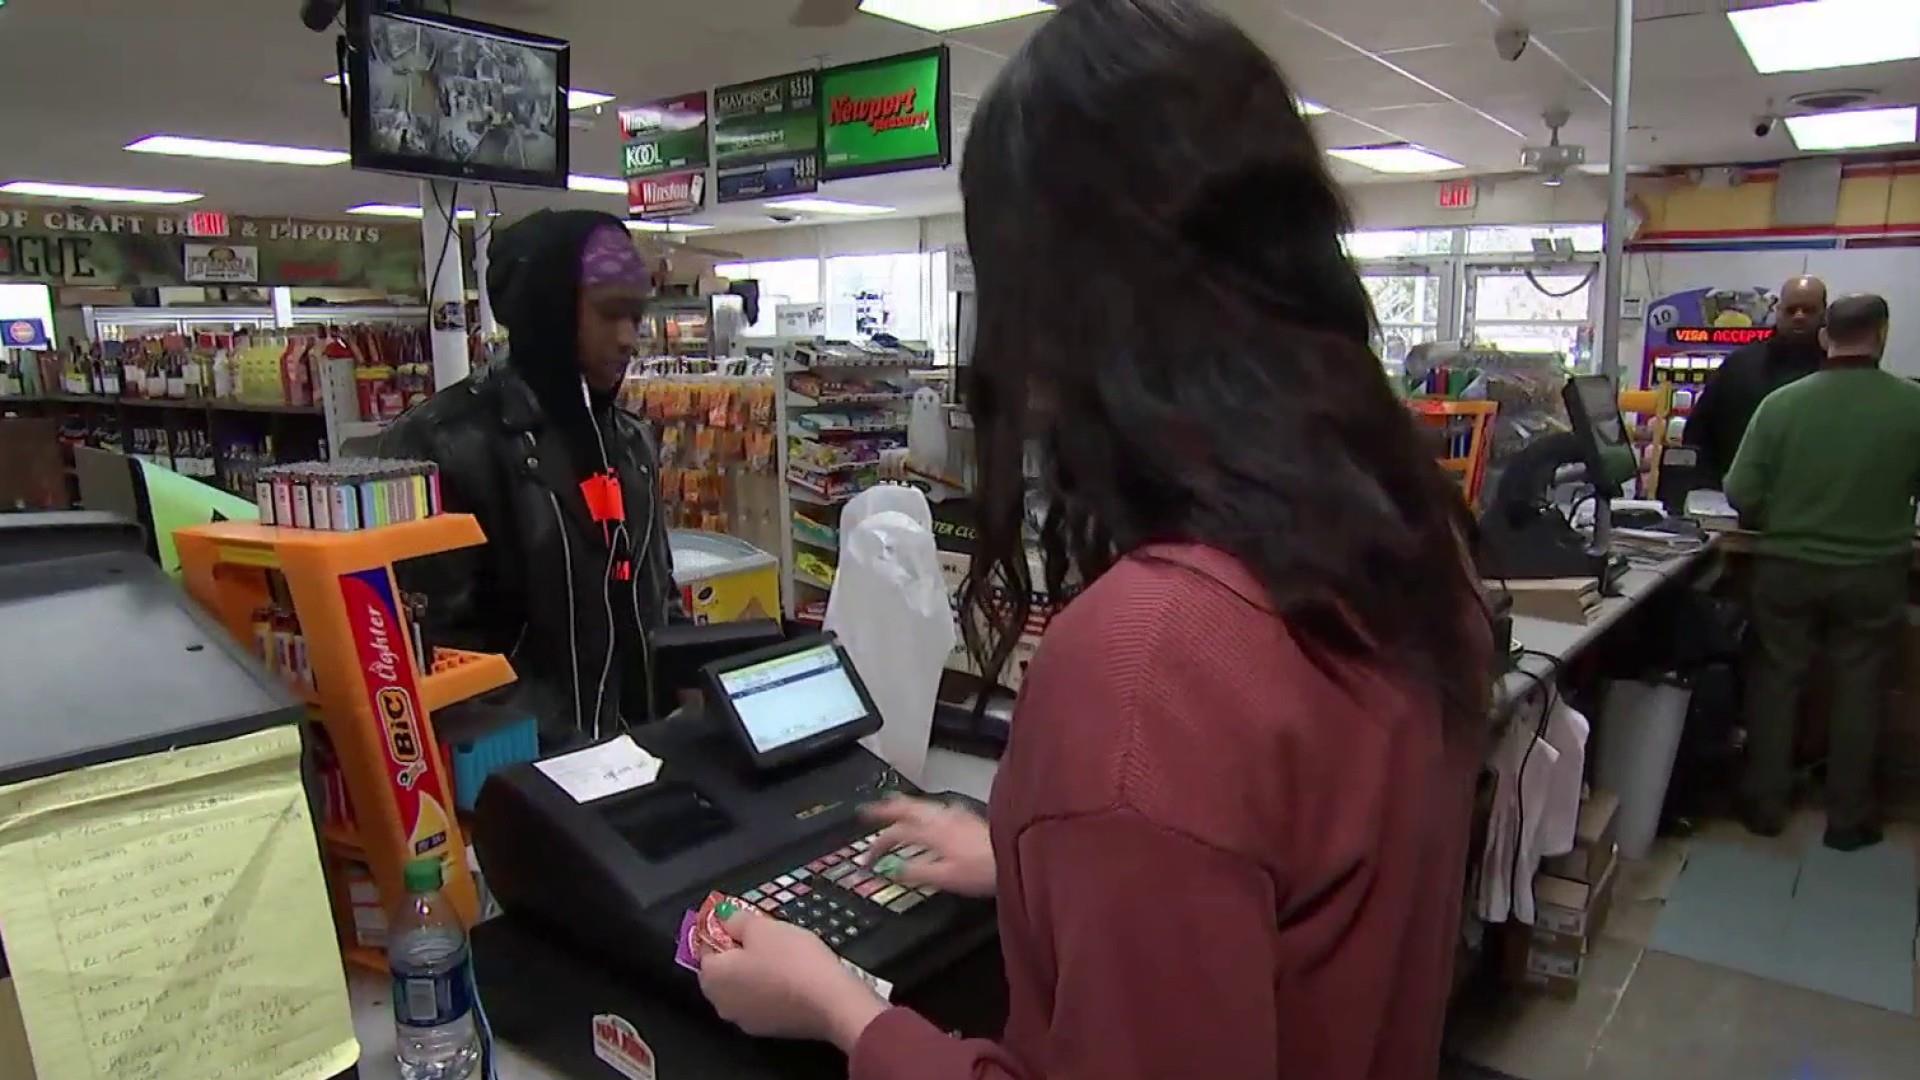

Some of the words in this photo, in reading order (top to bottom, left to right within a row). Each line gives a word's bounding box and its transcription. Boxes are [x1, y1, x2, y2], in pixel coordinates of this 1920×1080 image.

[719, 86, 779, 107] MAVERICK
[830, 87, 917, 127] Newport
[626, 143, 662, 168] KOOL
[643, 182, 689, 203] Winston
[1440, 178, 1472, 207] EXIT
[44, 212, 144, 234] CRAFT
[242, 222, 259, 237] &
[193, 211, 225, 235] EXIT
[1653, 309, 1672, 326] 10
[1676, 330, 1708, 341] VISA
